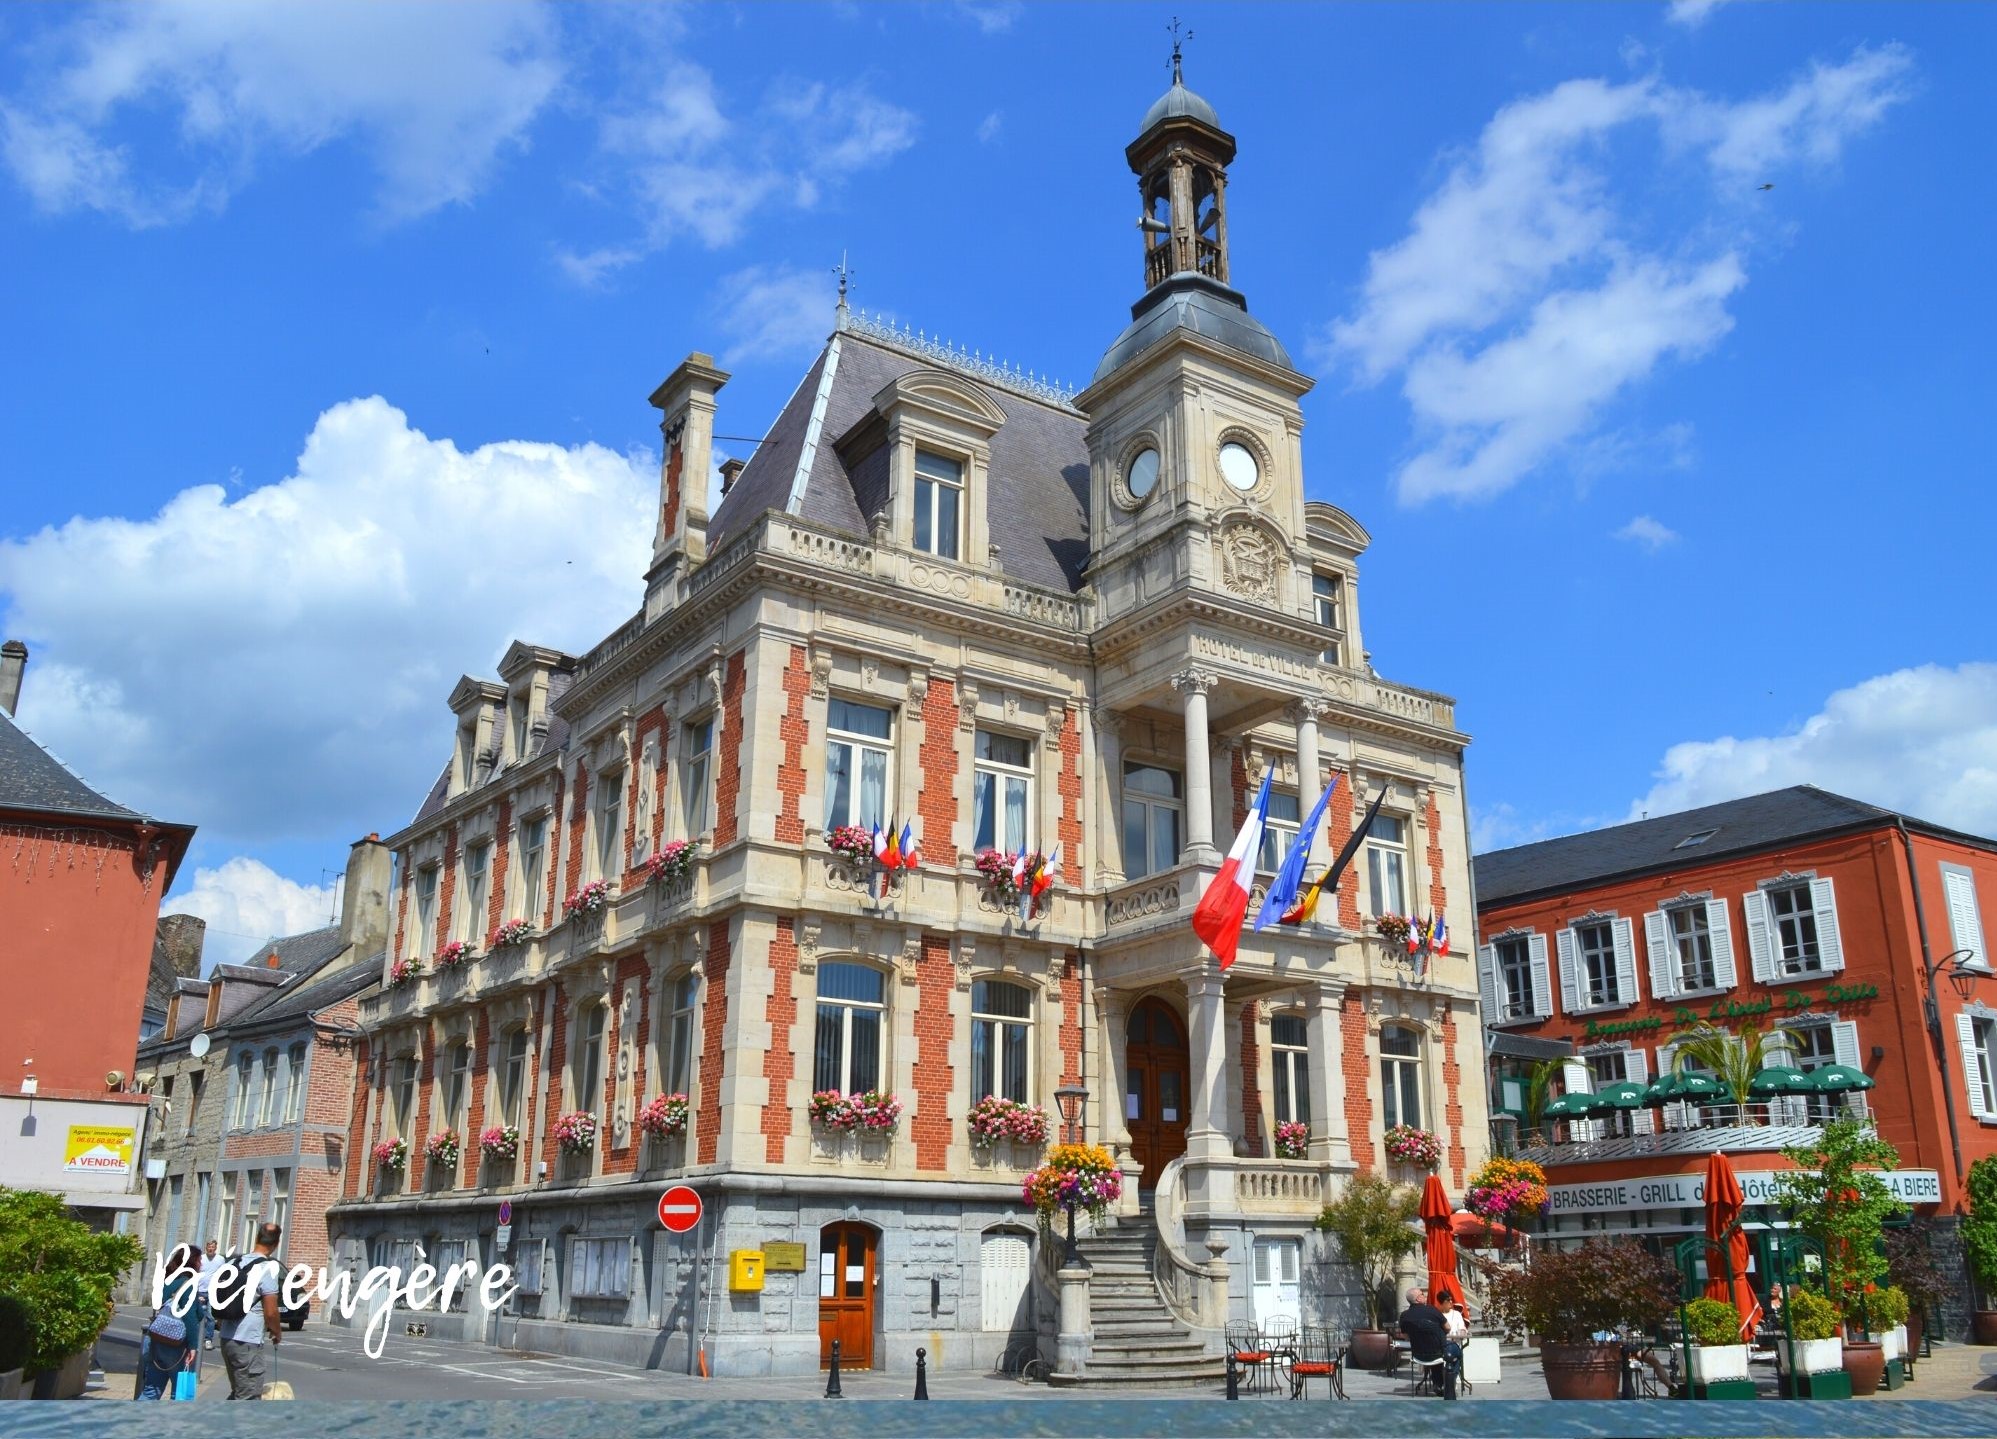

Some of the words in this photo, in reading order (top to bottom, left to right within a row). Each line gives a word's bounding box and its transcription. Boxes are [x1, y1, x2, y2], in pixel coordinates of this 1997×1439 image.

[1268, 652, 1311, 681] VILLE
[69, 1156, 77, 1166] A
[80, 1157, 127, 1168] VENDRE
[1553, 1186, 1627, 1209] BRASSERIE
[1640, 1183, 1686, 1204] GRILL
[1694, 1181, 1705, 1201] d
[1892, 1178, 1902, 1197] A
[1903, 1177, 1938, 1197] BIERE
